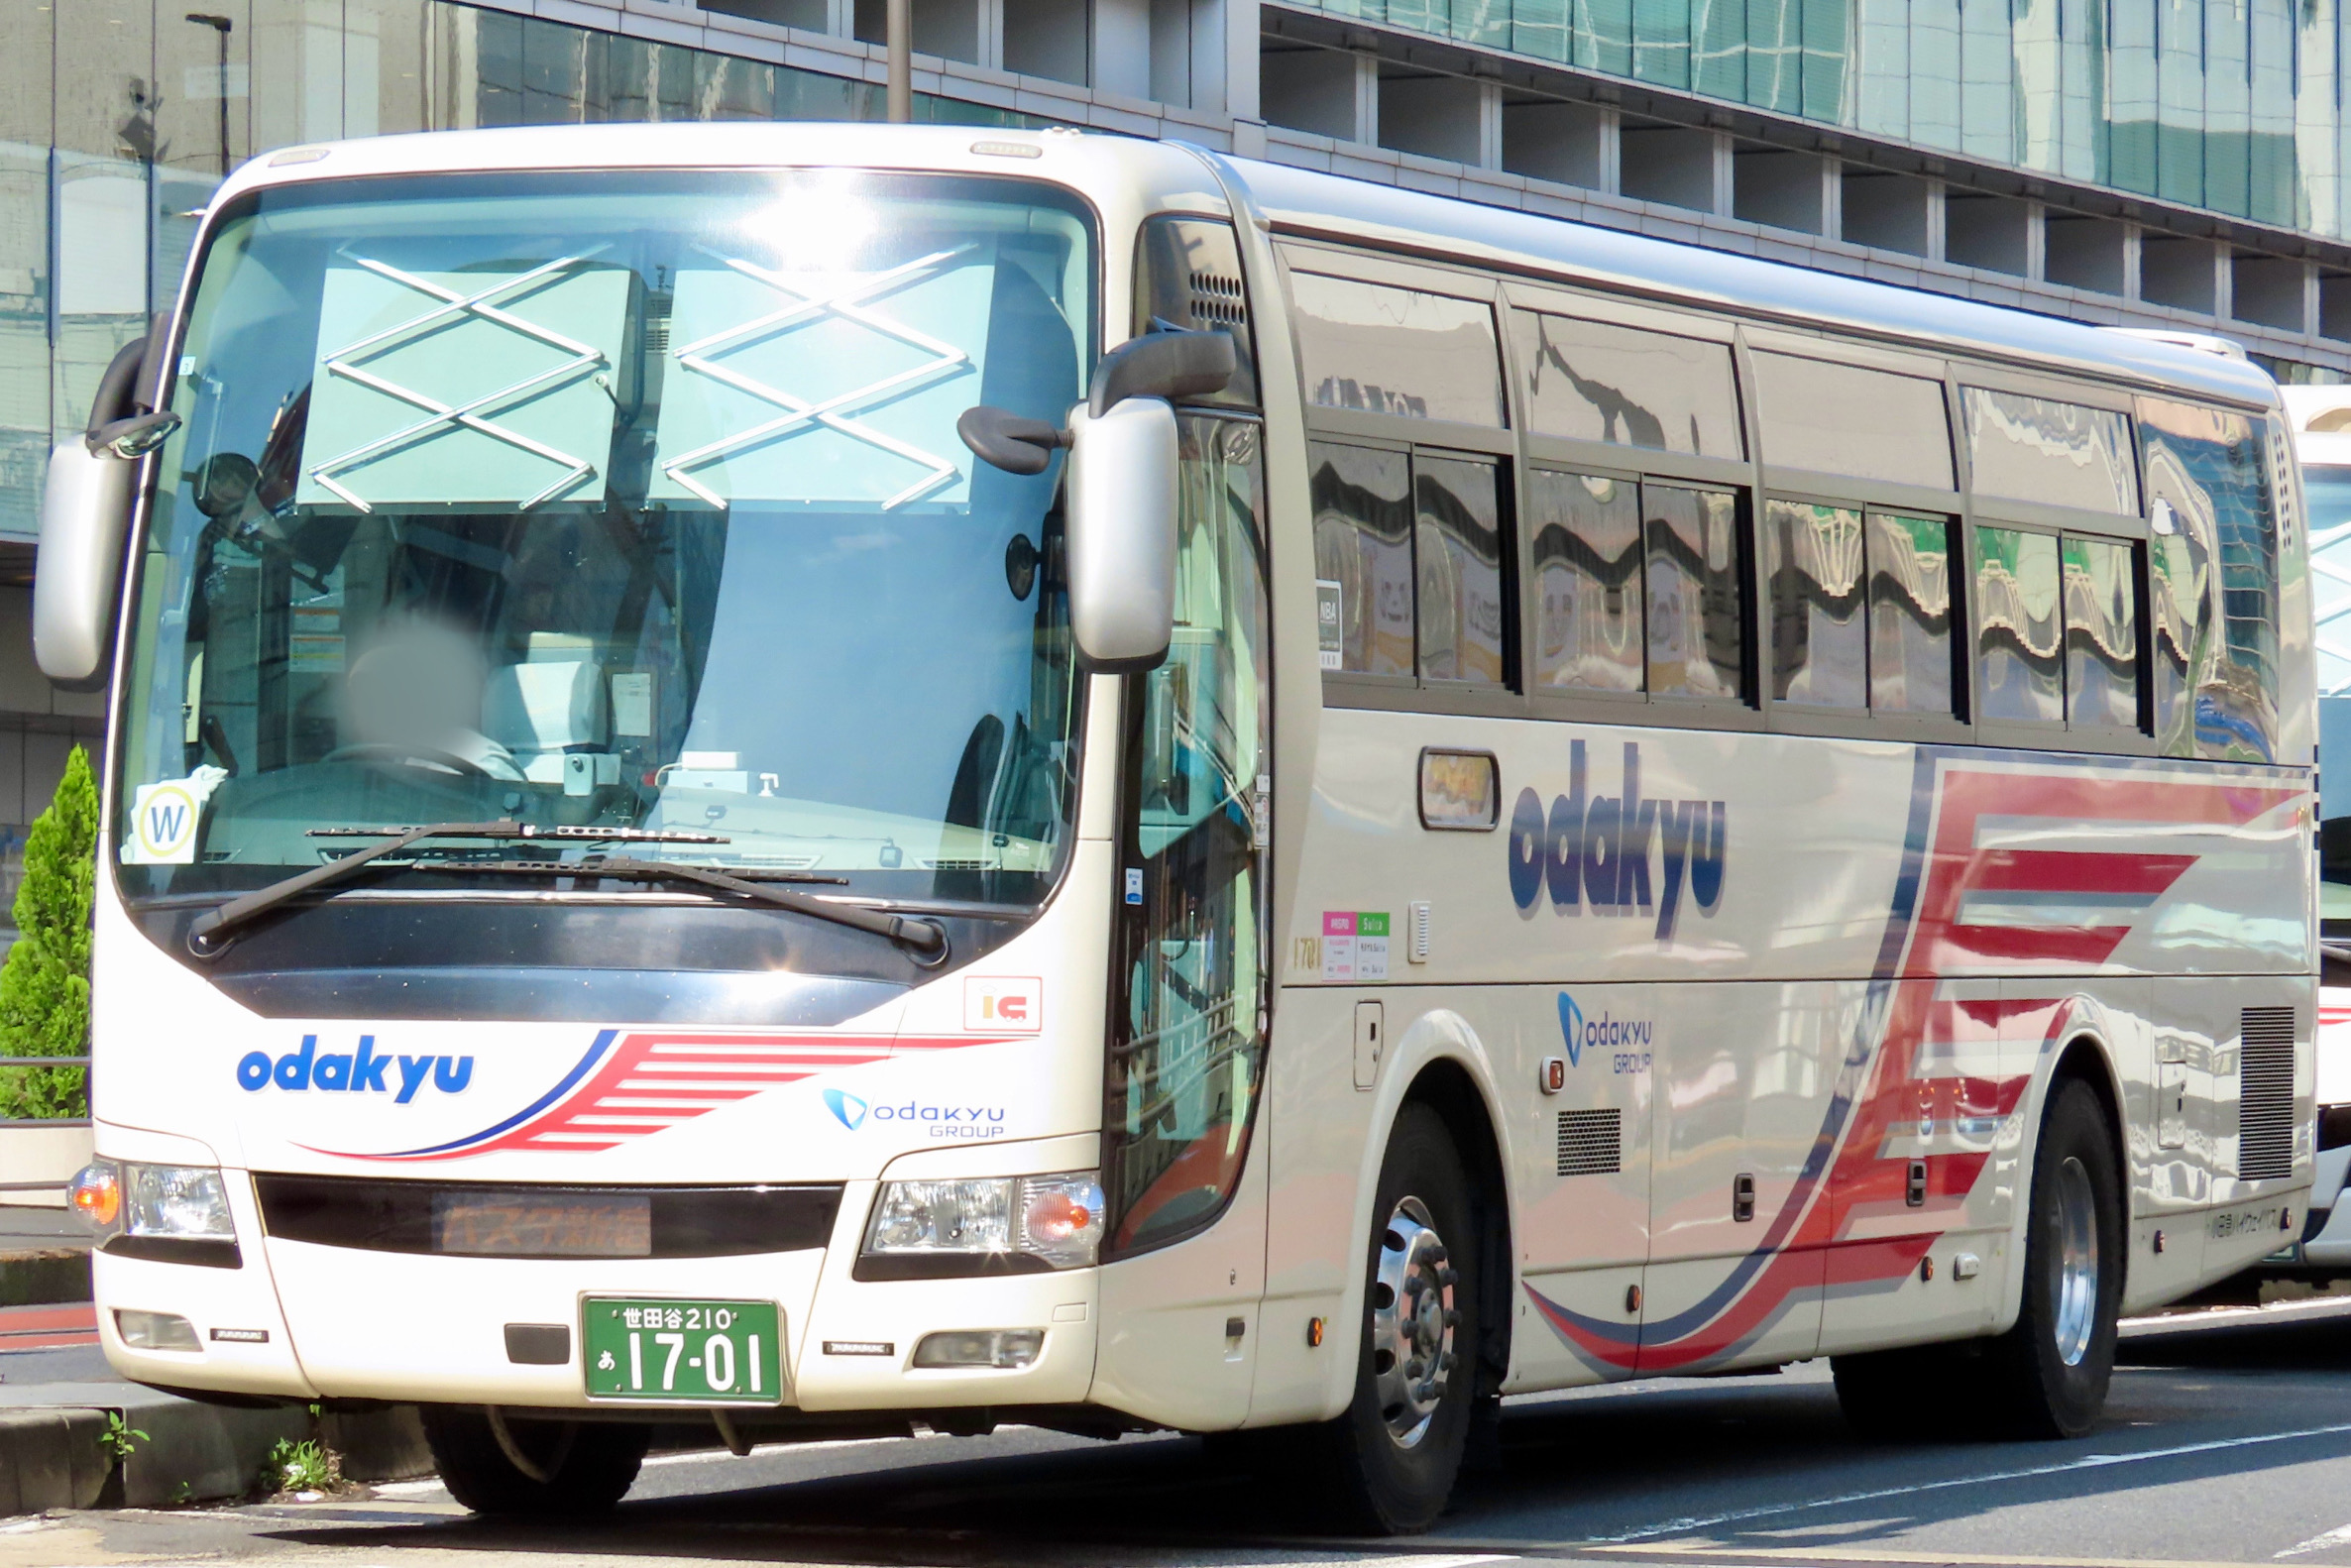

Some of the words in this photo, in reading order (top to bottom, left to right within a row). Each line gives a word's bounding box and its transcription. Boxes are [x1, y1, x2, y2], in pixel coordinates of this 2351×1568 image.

[151, 805, 185, 842] W
[1509, 738, 1728, 944] odakyu
[1363, 917, 1384, 931] Suica
[237, 1034, 475, 1104] odakyu
[1614, 1053, 1651, 1073] GROUP
[930, 1126, 1004, 1138] GROUP
[598, 1350, 616, 1371] あ
[628, 1332, 761, 1393] 17-01
